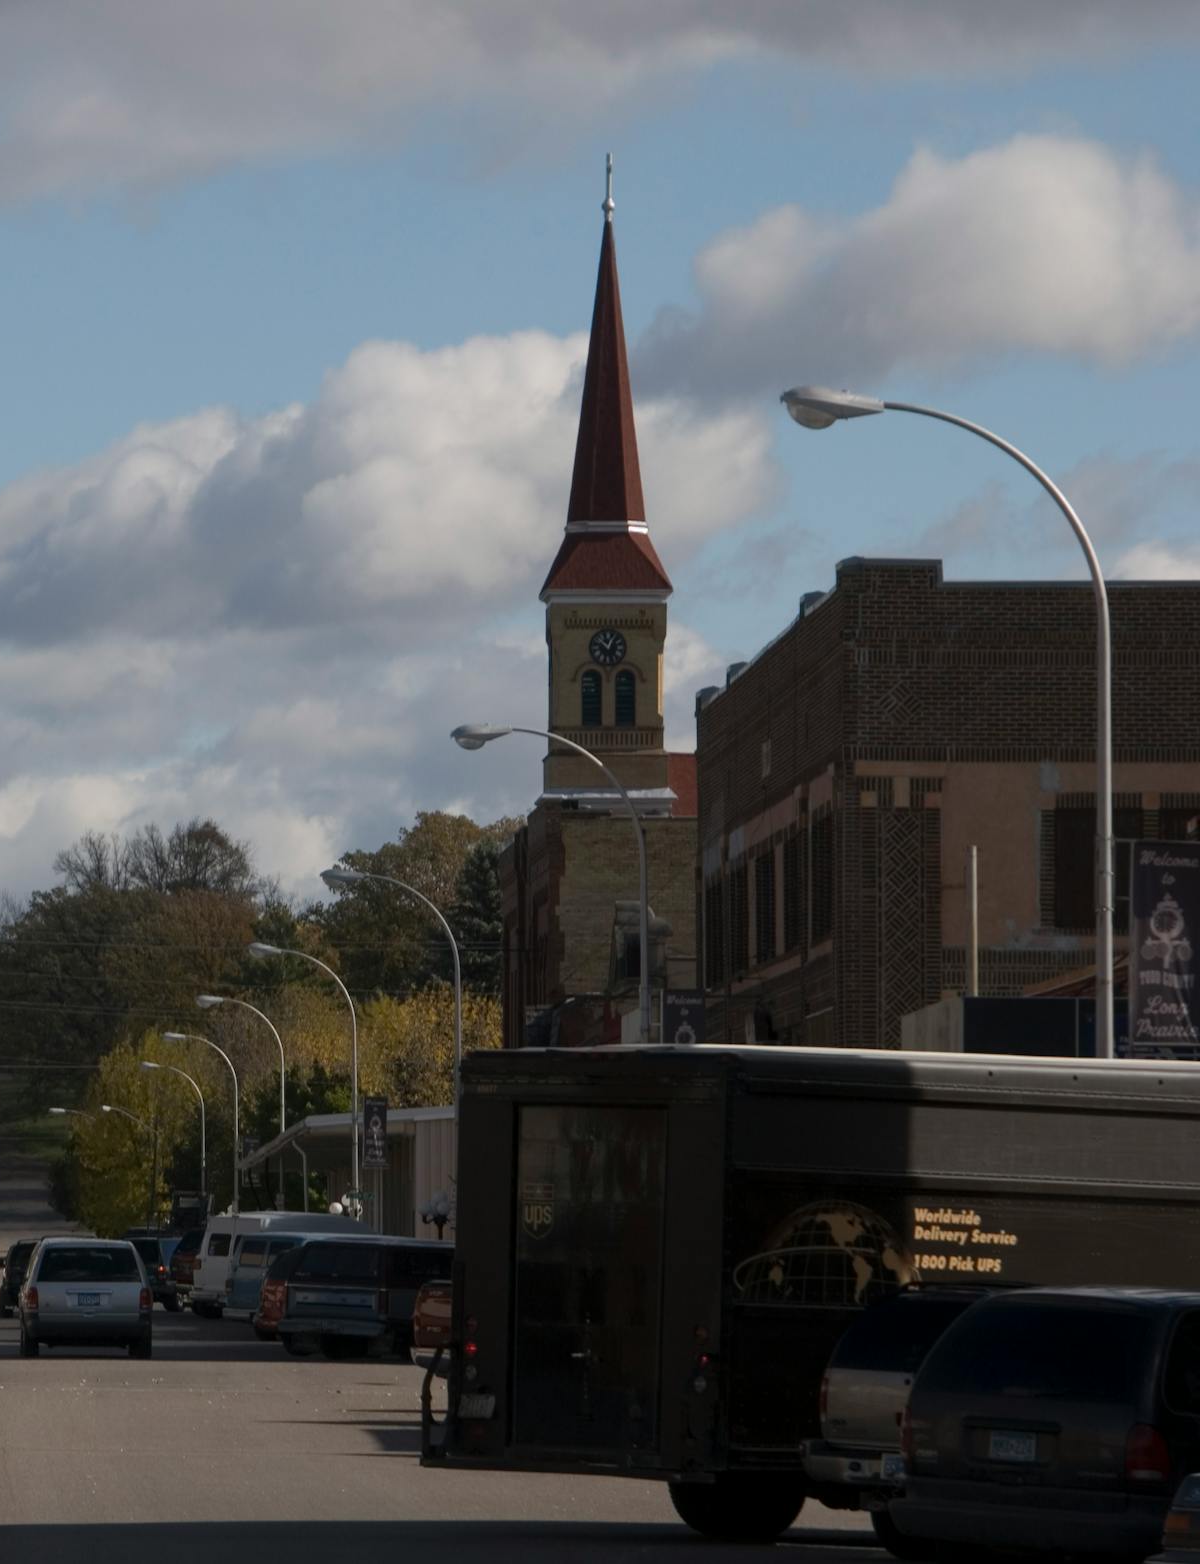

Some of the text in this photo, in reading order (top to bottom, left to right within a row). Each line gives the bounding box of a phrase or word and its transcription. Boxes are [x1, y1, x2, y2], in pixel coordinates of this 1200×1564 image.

[1138, 849, 1199, 868] Welcome
[1161, 872, 1176, 885] to
[1143, 994, 1189, 1021] Long
[1135, 1017, 1199, 1038] Prairie
[913, 1207, 982, 1226] Worldwide
[913, 1225, 1018, 1246] Delivery Service
[948, 1255, 975, 1272] Pick
[976, 1257, 1002, 1273] UPS
